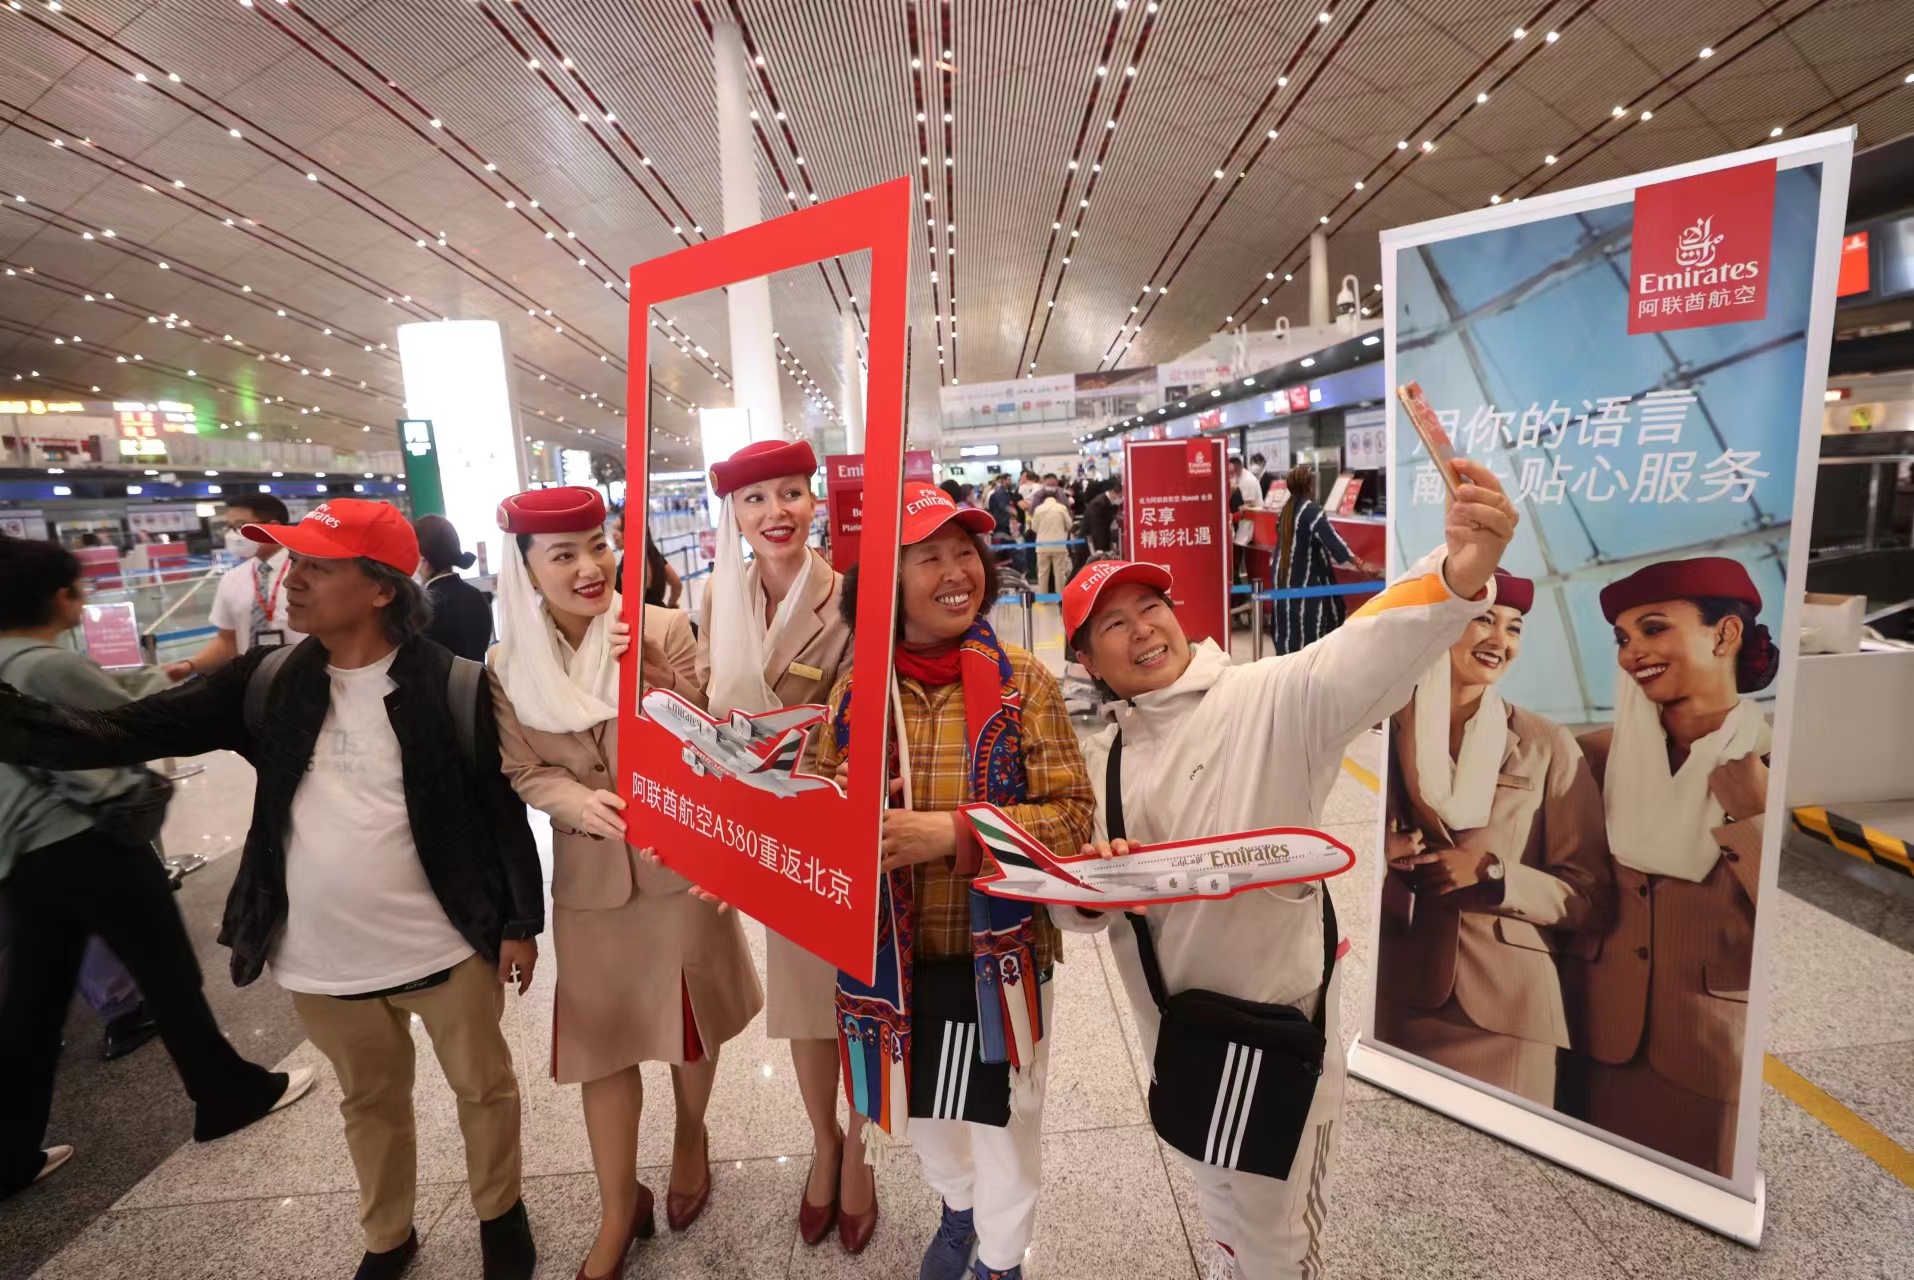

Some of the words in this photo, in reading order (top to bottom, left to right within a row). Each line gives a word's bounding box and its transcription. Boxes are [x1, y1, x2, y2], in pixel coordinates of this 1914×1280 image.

[1640, 261, 1759, 294] Emirates
[1638, 285, 1756, 318] 阿联酋航空
[919, 489, 937, 497] Fly
[1140, 506, 1175, 526] 尽享
[1140, 526, 1211, 548] 精彩礼遇
[632, 771, 852, 910] 阿联酋航空A380重返北京
[1210, 844, 1290, 867] Emirates
